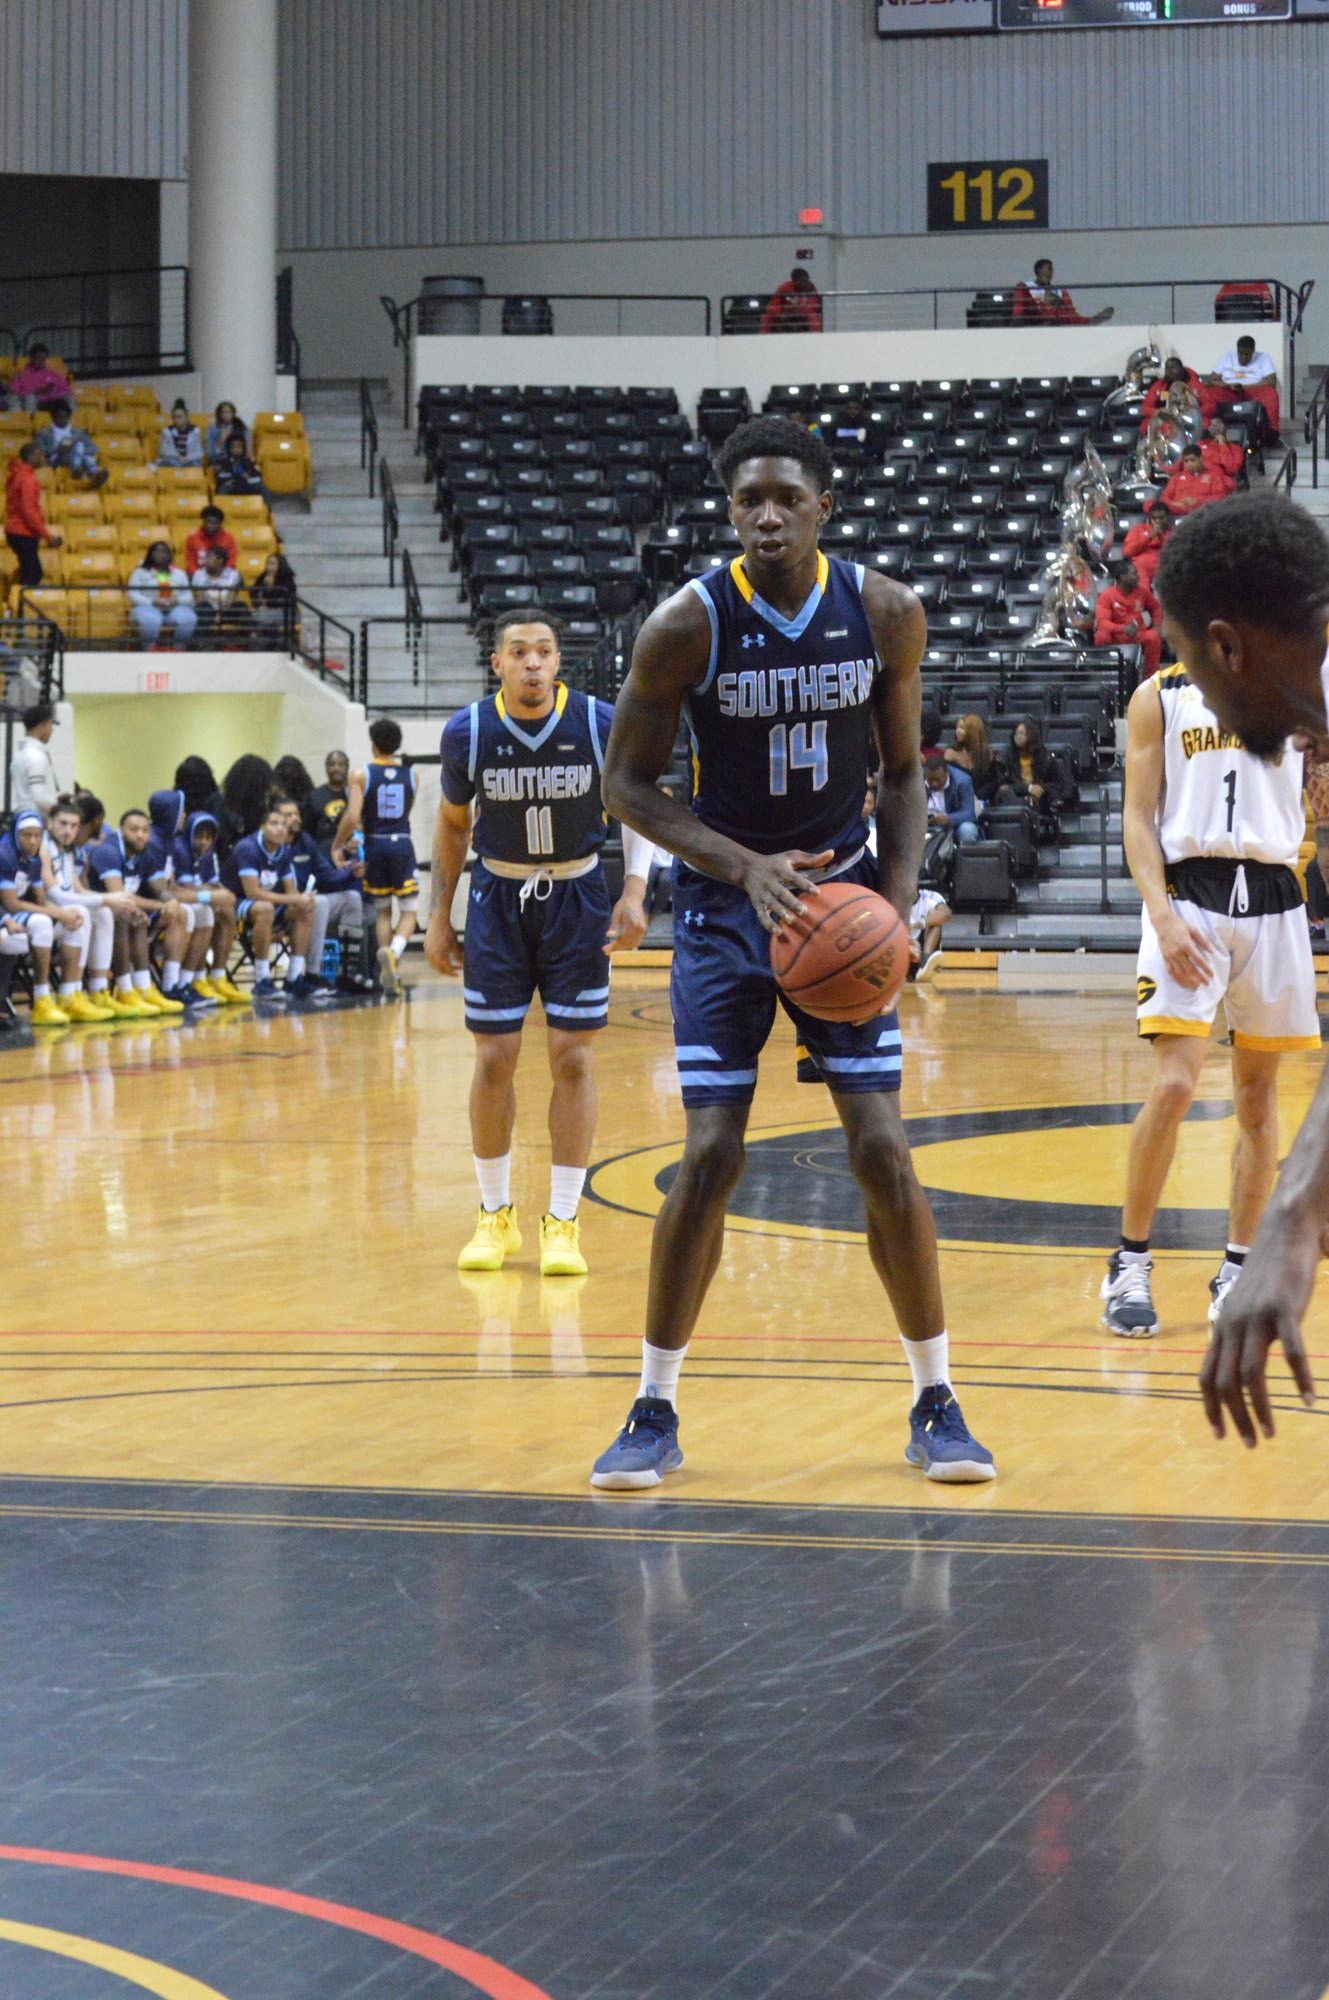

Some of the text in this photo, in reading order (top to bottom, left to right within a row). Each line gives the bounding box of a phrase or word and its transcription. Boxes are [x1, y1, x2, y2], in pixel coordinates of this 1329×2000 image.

[1223, 4, 1257, 15] BONUS
[940, 168, 1035, 223] 112
[146, 671, 170, 689] EXIT
[717, 658, 873, 718] SOUTHERN
[482, 764, 593, 801] SOUTHERN
[768, 719, 829, 796] 14
[1223, 769, 1238, 833] 1
[525, 805, 554, 855] 11
